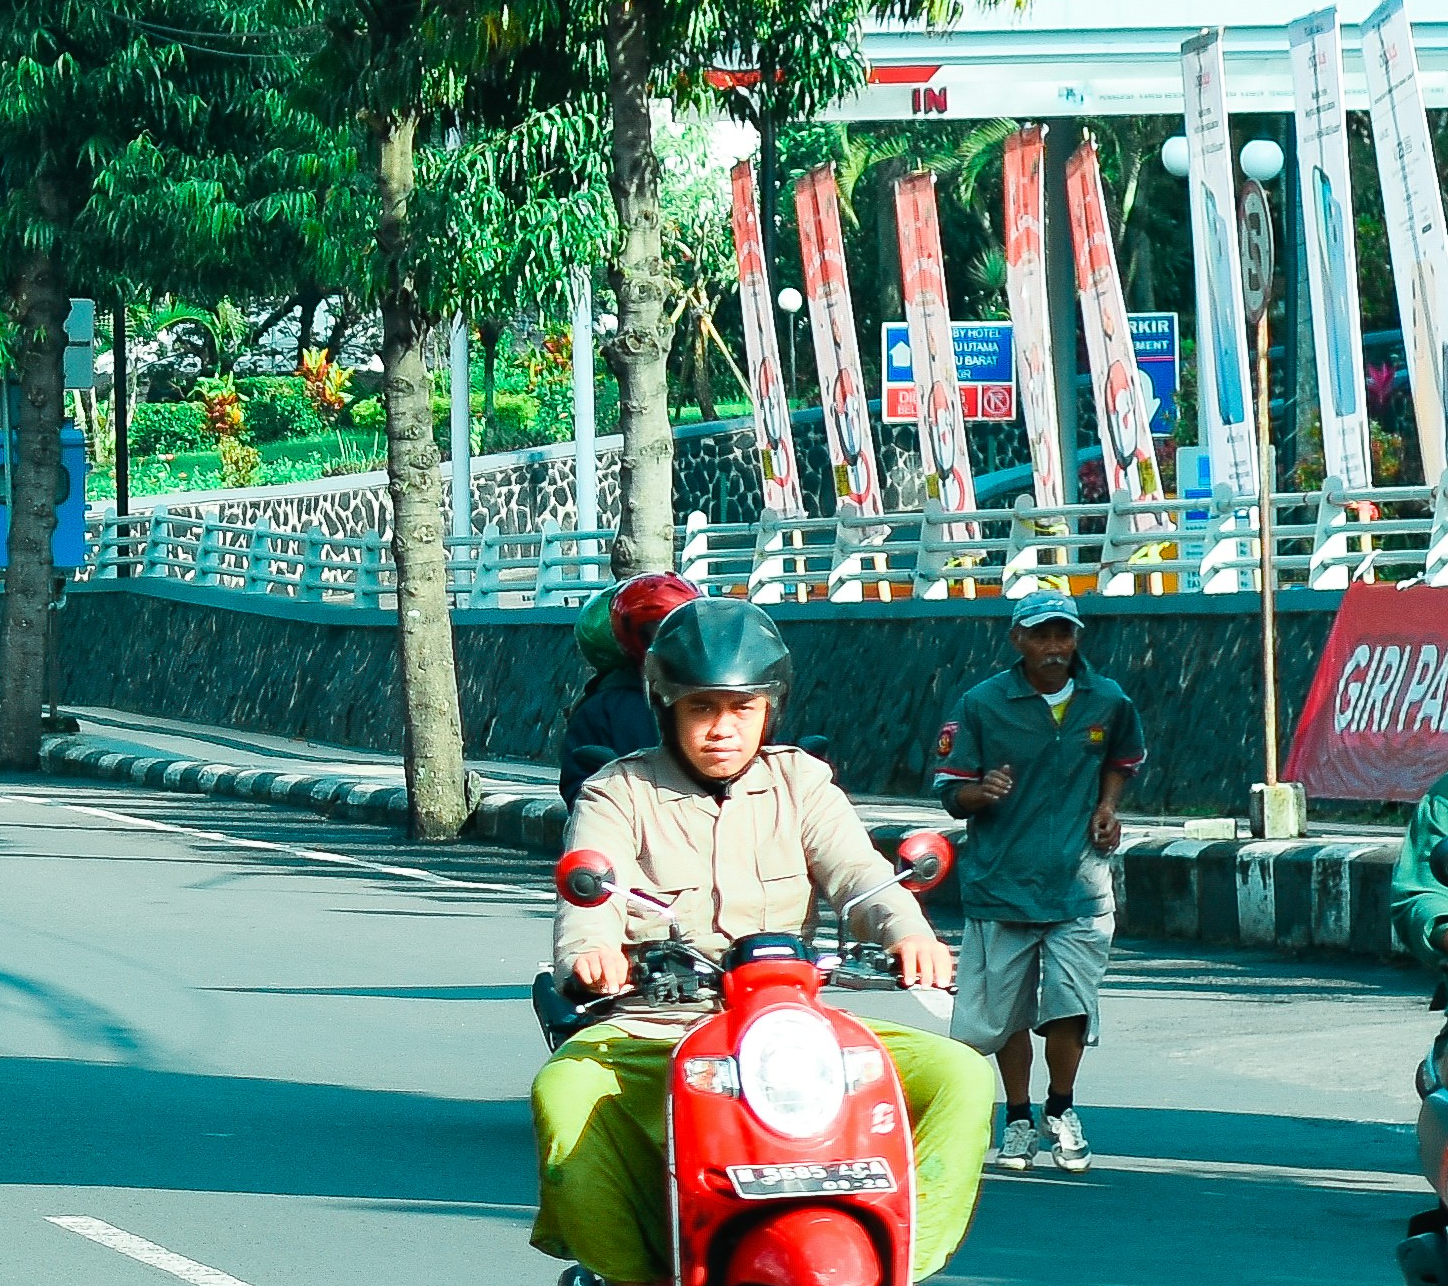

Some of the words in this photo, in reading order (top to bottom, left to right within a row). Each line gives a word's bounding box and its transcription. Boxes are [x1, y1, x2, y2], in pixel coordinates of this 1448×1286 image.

[911, 86, 947, 114] IN
[1129, 320, 1169, 333] RKIR
[968, 328, 1001, 338] HOTEL
[964, 342, 999, 353] UTAMA
[965, 356, 998, 366] BARAT
[1334, 643, 1411, 734] GIRI
[1397, 643, 1448, 733] PA
